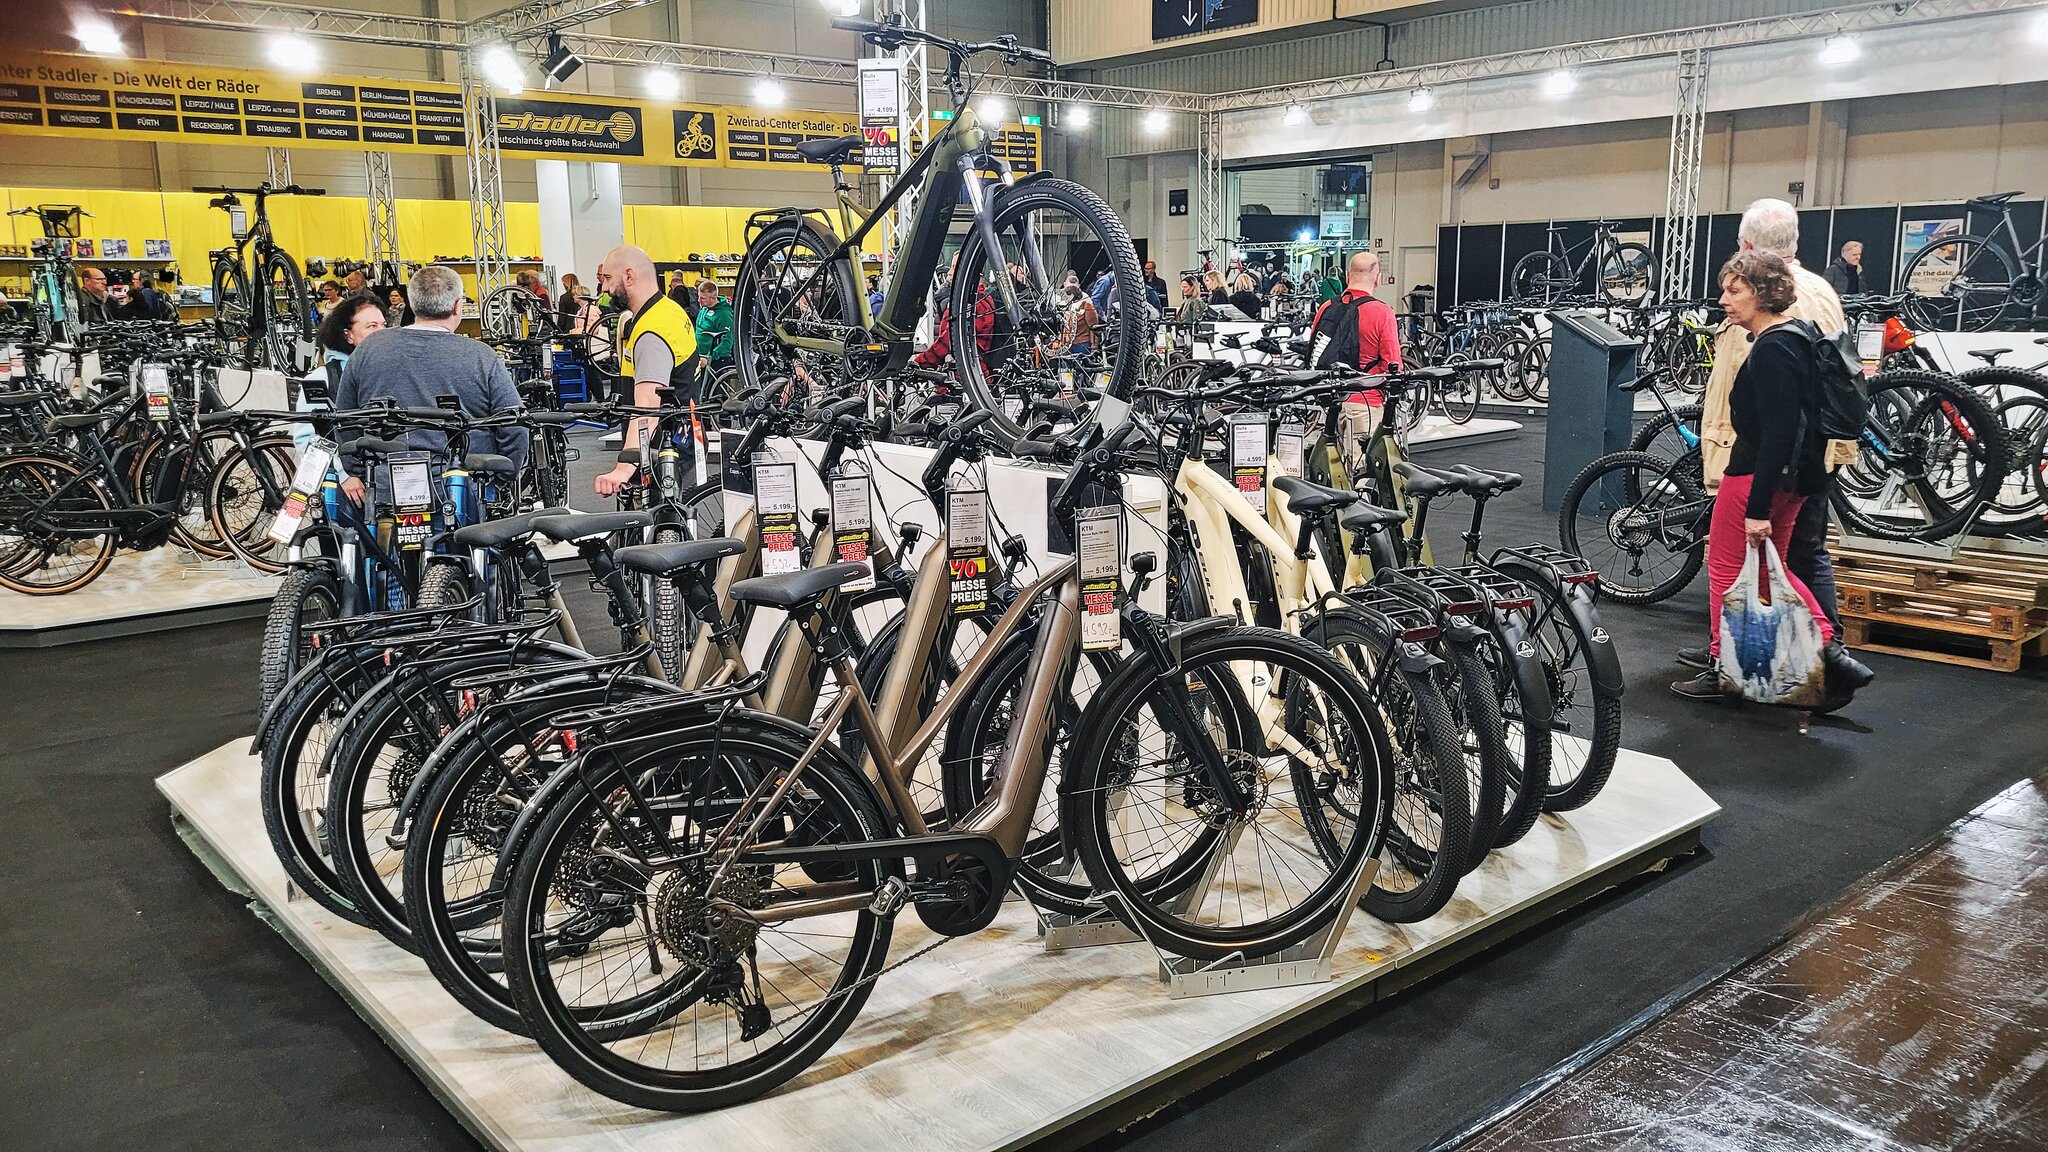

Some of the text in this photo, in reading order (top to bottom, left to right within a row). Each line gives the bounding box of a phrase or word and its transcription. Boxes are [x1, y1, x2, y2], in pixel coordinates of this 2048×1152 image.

[38, 65, 97, 83] Stadler
[113, 71, 140, 86] Die
[144, 73, 182, 89] Welt
[187, 76, 211, 91] der
[216, 79, 260, 94] Räder
[54, 91, 101, 102] DÜSSELDORF
[316, 88, 341, 96] BREMEN
[362, 91, 382, 99] BERLIN
[185, 100, 210, 109] LEIPZIG
[248, 104, 272, 112] LEIPZIG
[316, 108, 346, 117] CHEMNITZ
[60, 114, 100, 124] NÜRNBERG
[137, 118, 160, 127] FÜRTH
[420, 114, 452, 123] FRANKFURT
[497, 112, 617, 135] stadler
[190, 121, 234, 131] REGENSBURG
[256, 124, 292, 134] STRAUBING
[727, 115, 800, 130] Zweirad-Center
[803, 120, 835, 132] Stadler
[843, 122, 857, 133] Die
[318, 128, 348, 136] MÜNCHEN
[372, 131, 404, 140] HAMMERAU
[544, 138, 570, 148] größte
[571, 138, 620, 149] Rad-Auswahl
[865, 146, 897, 156] MESSE
[864, 156, 898, 166] PREISE
[1240, 484, 1260, 492] PREIS
[398, 526, 432, 535] MESSE
[764, 534, 796, 543] MESSE-
[768, 542, 794, 552] PREIS
[839, 542, 868, 554] MESSE-
[843, 552, 867, 562] PREIS
[1096, 565, 1117, 574] 5.199,-
[952, 579, 986, 592] MESSE
[951, 590, 988, 603] PREISE
[1084, 592, 1116, 604] MESSE-
[1088, 603, 1114, 616] PREIS
[857, 810, 874, 840] SCHWALB
